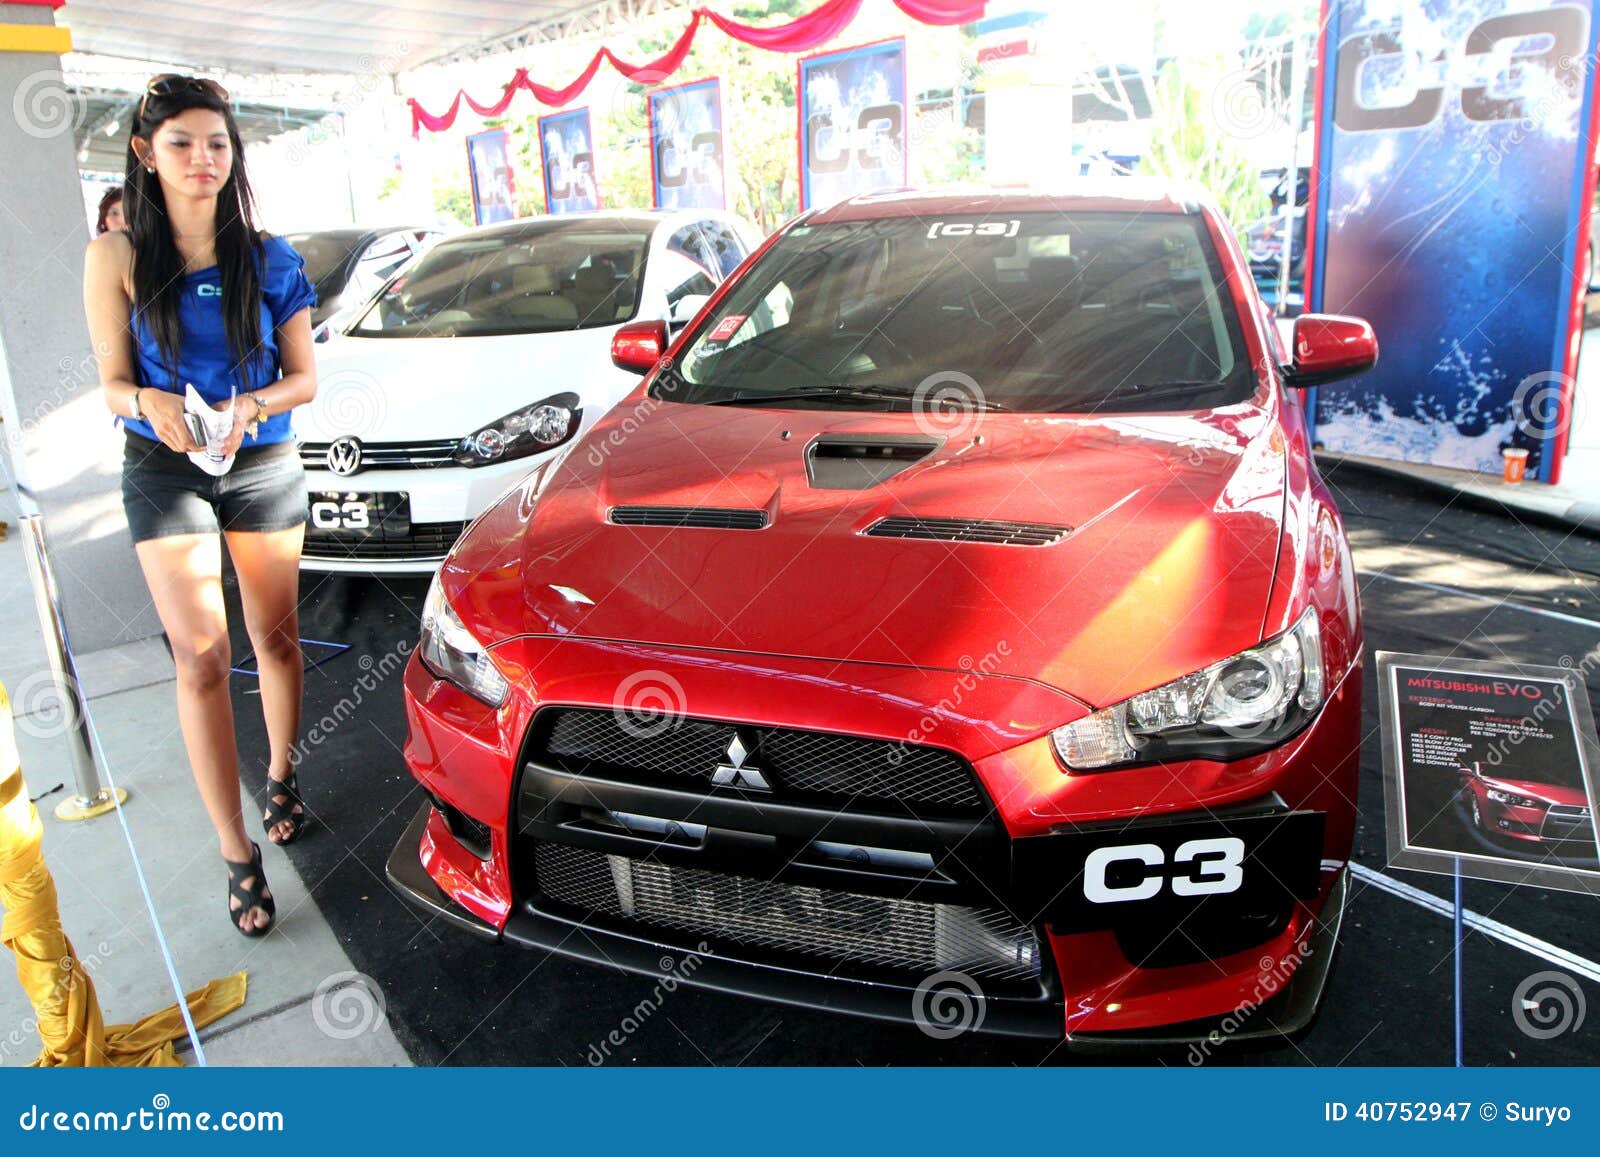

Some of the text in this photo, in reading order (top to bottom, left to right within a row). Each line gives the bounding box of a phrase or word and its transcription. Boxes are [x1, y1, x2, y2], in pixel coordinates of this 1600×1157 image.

[1335, 8, 1590, 131] C3
[808, 104, 904, 173] C3
[311, 502, 369, 528] C3
[1407, 677, 1543, 699] MITSUBISHI EVO
[1083, 837, 1246, 904] C3
